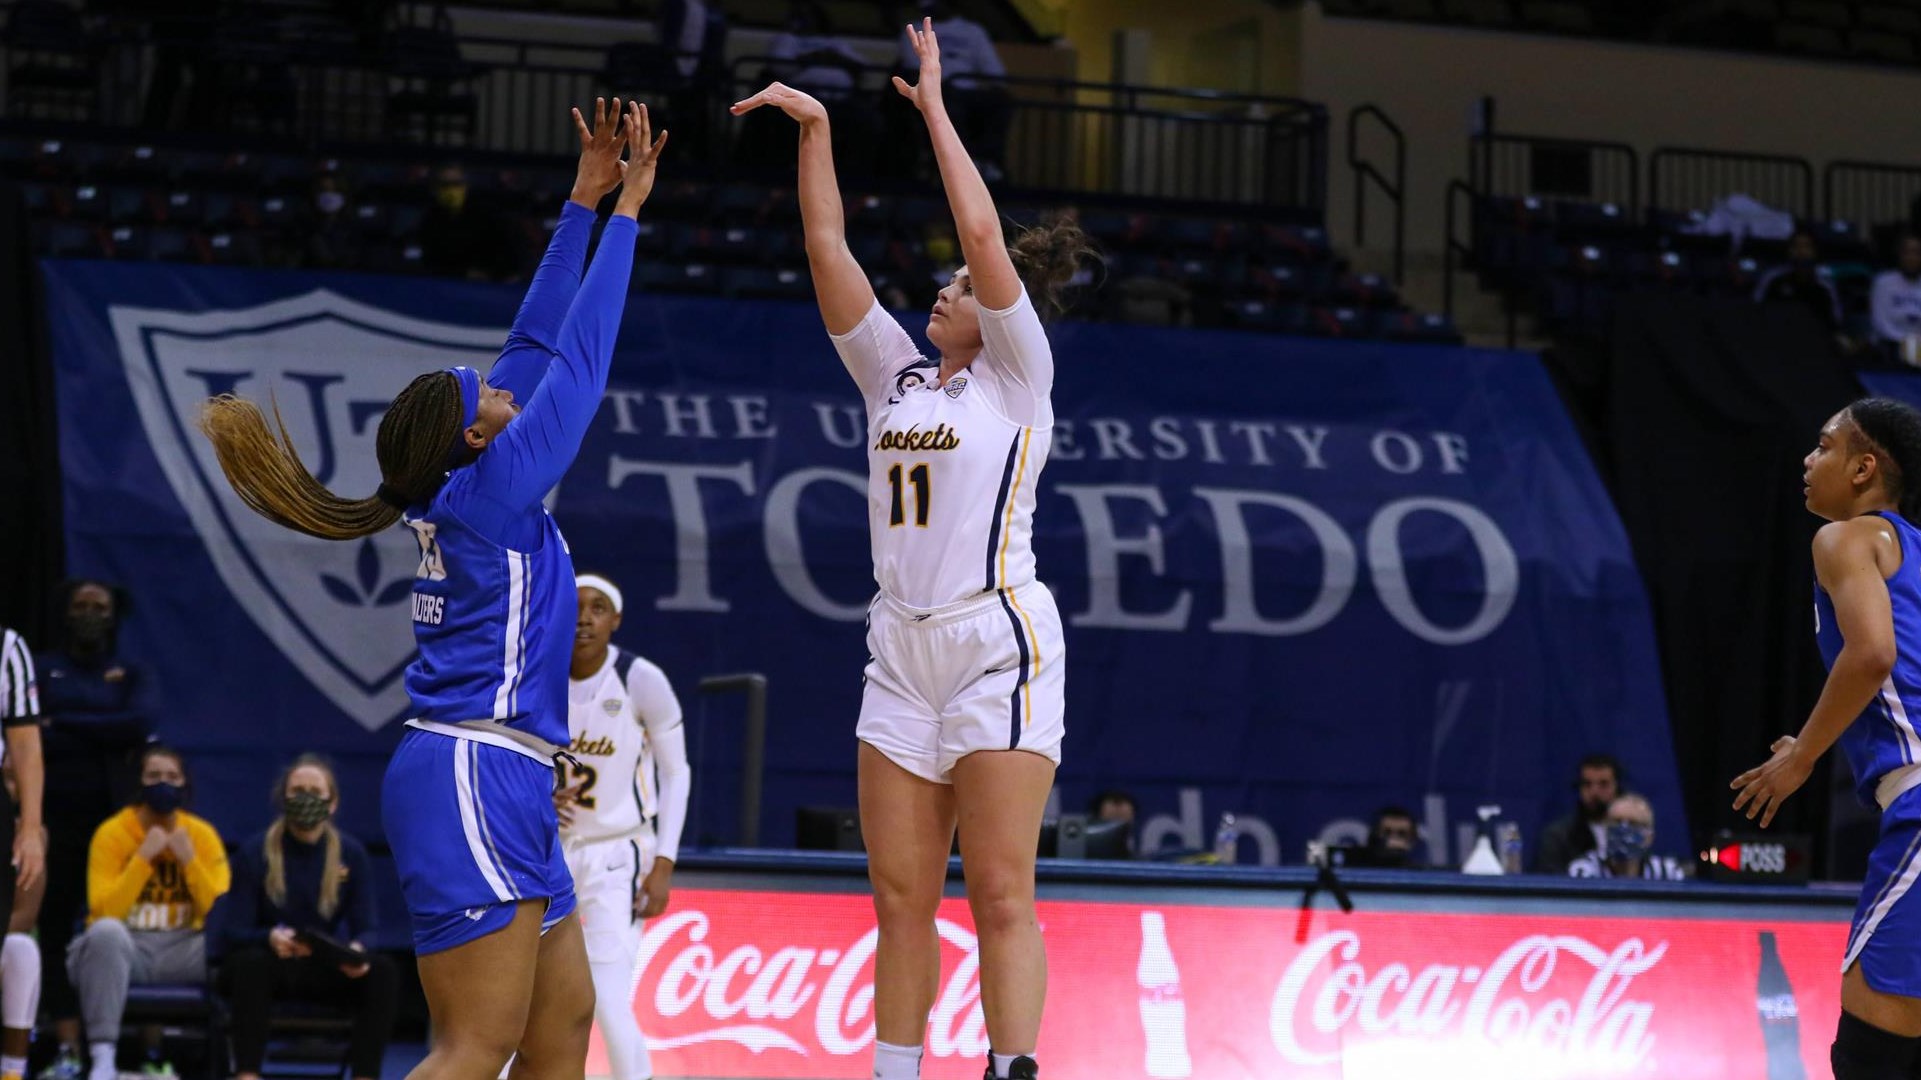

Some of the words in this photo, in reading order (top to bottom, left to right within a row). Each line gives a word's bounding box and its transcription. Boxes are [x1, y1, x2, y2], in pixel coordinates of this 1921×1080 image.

[609, 391, 778, 439] THE
[811, 402, 1330, 470] UERSITY
[1370, 429, 1471, 475] OF
[875, 422, 961, 452] ockets
[888, 461, 932, 528] 11
[607, 455, 1520, 647] TOEDO
[1740, 842, 1786, 874] POSS
[1269, 929, 1671, 1070] Coca-Cola
